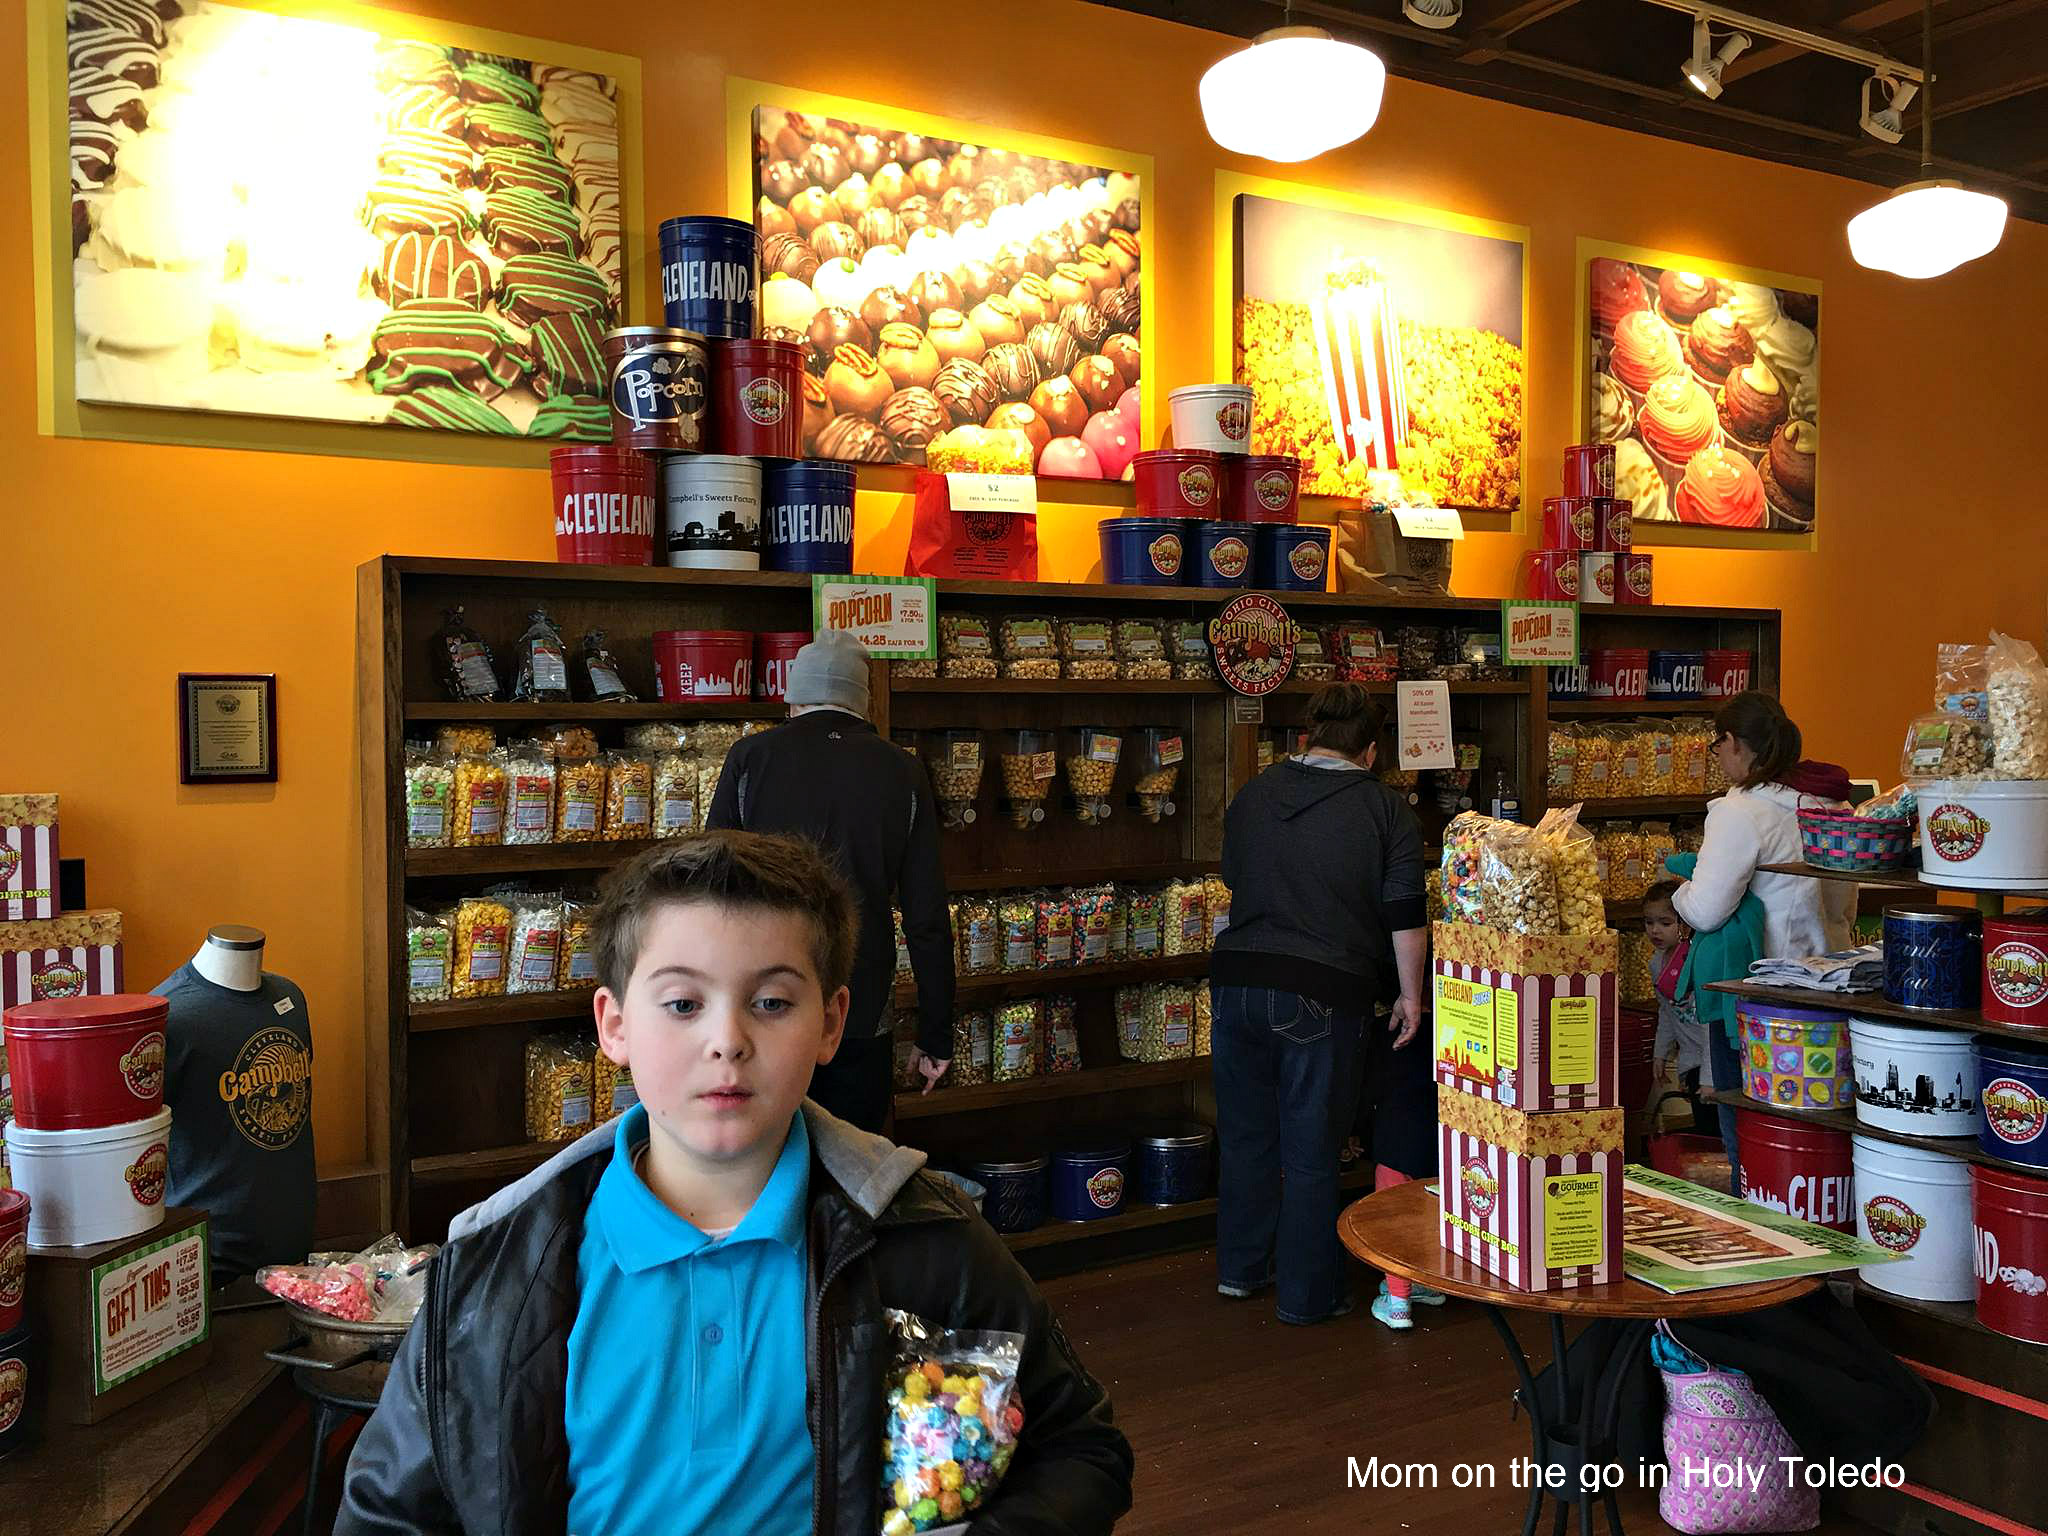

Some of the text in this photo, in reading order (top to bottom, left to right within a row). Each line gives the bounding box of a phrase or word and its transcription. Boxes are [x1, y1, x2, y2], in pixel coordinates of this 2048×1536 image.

[662, 261, 748, 304] CLEVELAND
[620, 369, 704, 432] Popcorn
[705, 493, 732, 502] Sweets
[766, 504, 852, 545] CLEVELAND
[829, 592, 892, 630] POPCORN
[1225, 597, 1284, 620] OHIO CITY
[860, 635, 887, 646] $4.25
[1209, 618, 1301, 651] Campbell's
[1512, 613, 1552, 644] POPCORN
[680, 662, 693, 696] KEEP
[1217, 641, 1292, 692] SWEETS FACTORY
[1927, 817, 1992, 836] Campbell's
[26, 889, 51, 899] BOX
[32, 969, 87, 985] Campbell's
[1444, 980, 1472, 1005] CLEVELAND
[1561, 1181, 1598, 1191] GOURMET
[1864, 1202, 1927, 1229] Campbell's
[1444, 1211, 1519, 1258] POPCORN GIFT BOX
[176, 1250, 198, 1267] $17.95
[107, 1261, 171, 1337] GIFT TINS
